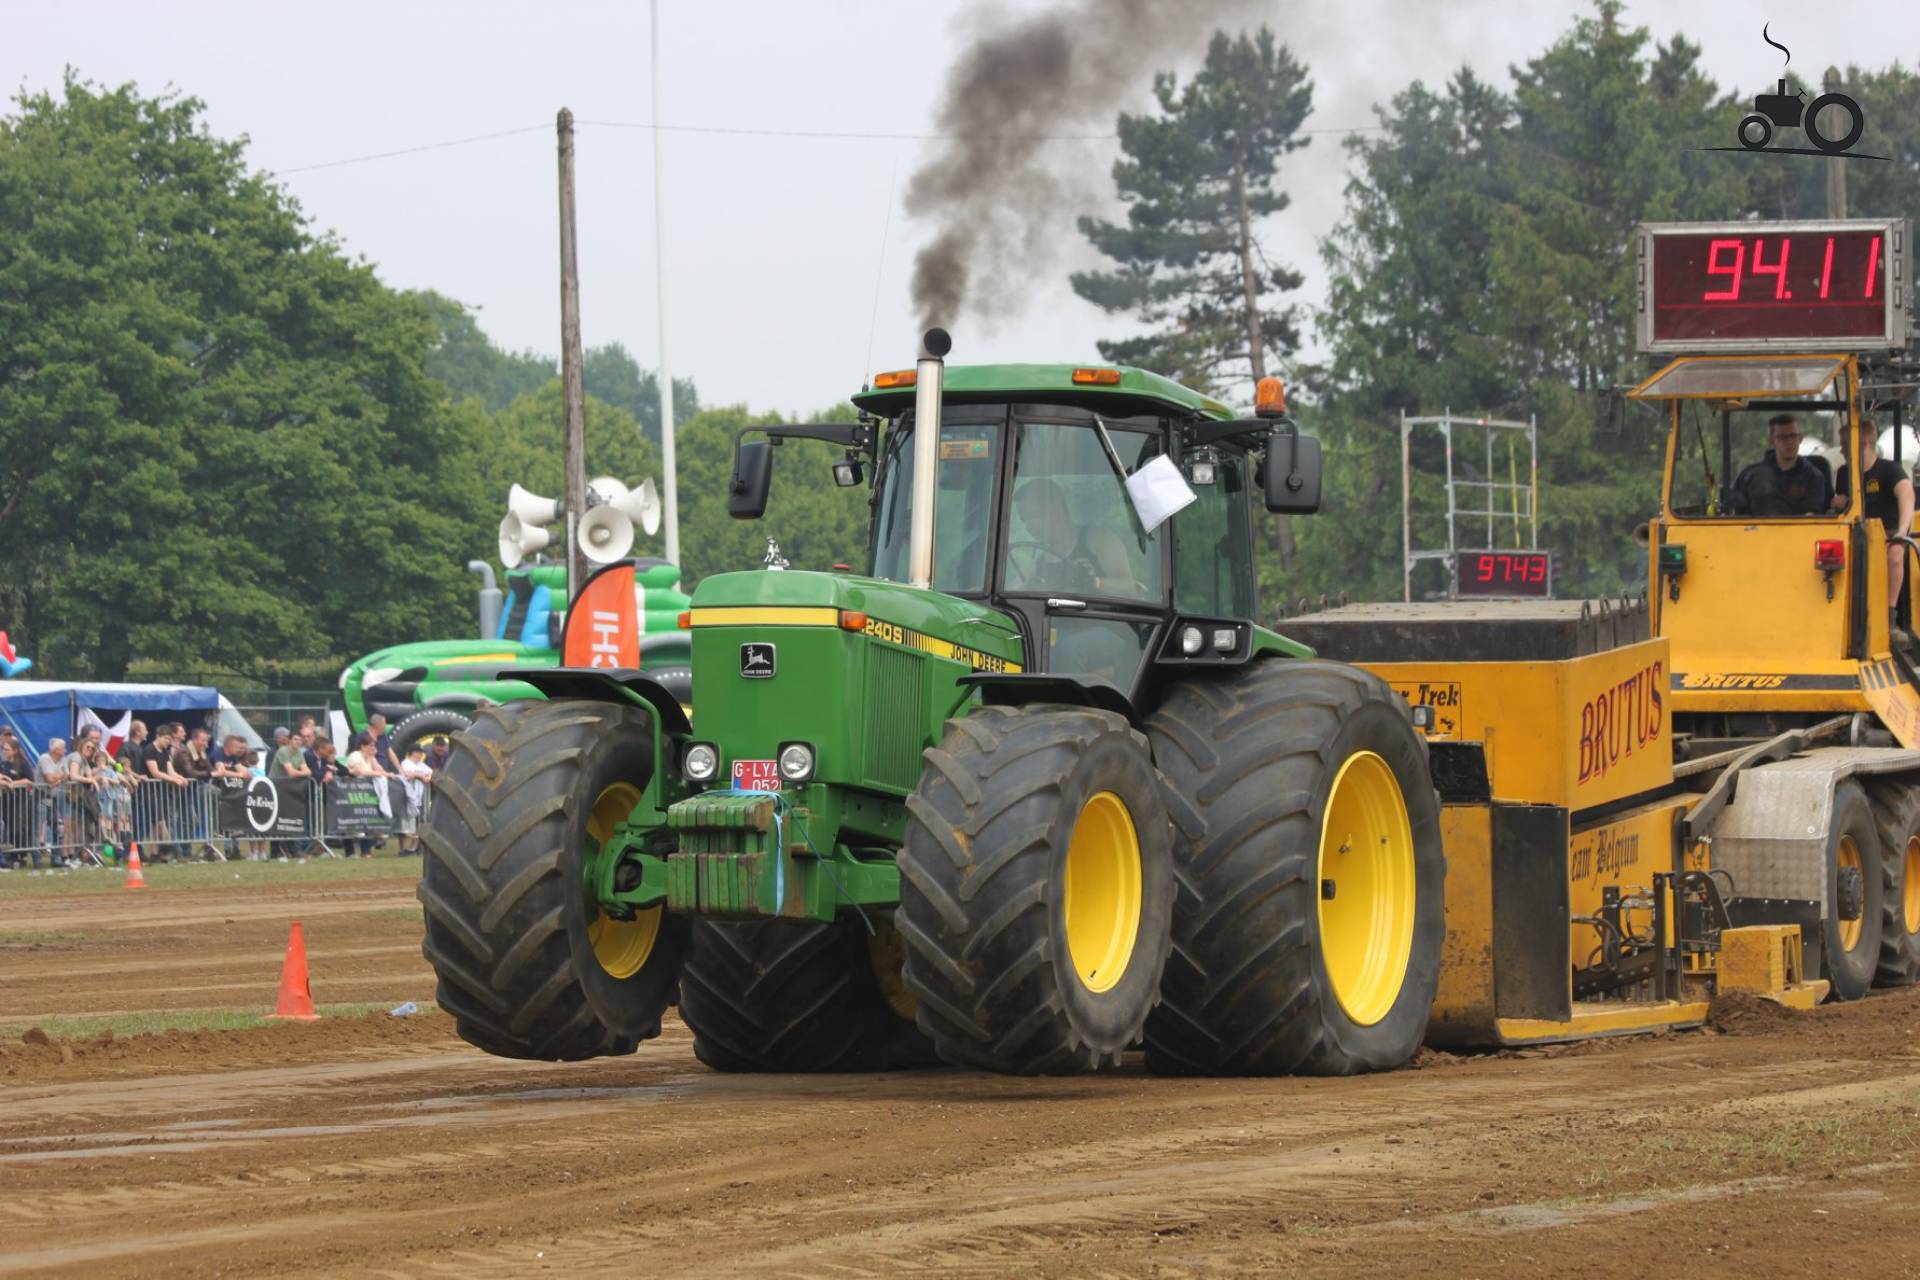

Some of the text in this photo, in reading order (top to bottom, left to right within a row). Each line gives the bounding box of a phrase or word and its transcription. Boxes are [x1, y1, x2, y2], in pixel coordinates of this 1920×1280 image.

[1704, 238, 1880, 300] 94.11
[862, 617, 903, 644] 240S
[950, 645, 1006, 672] JOHN DEERE
[1681, 673, 1788, 688] BRUTUS
[1419, 684, 1458, 706] Trek
[1578, 661, 1662, 786] BRUTUS
[1570, 840, 1591, 882] eam
